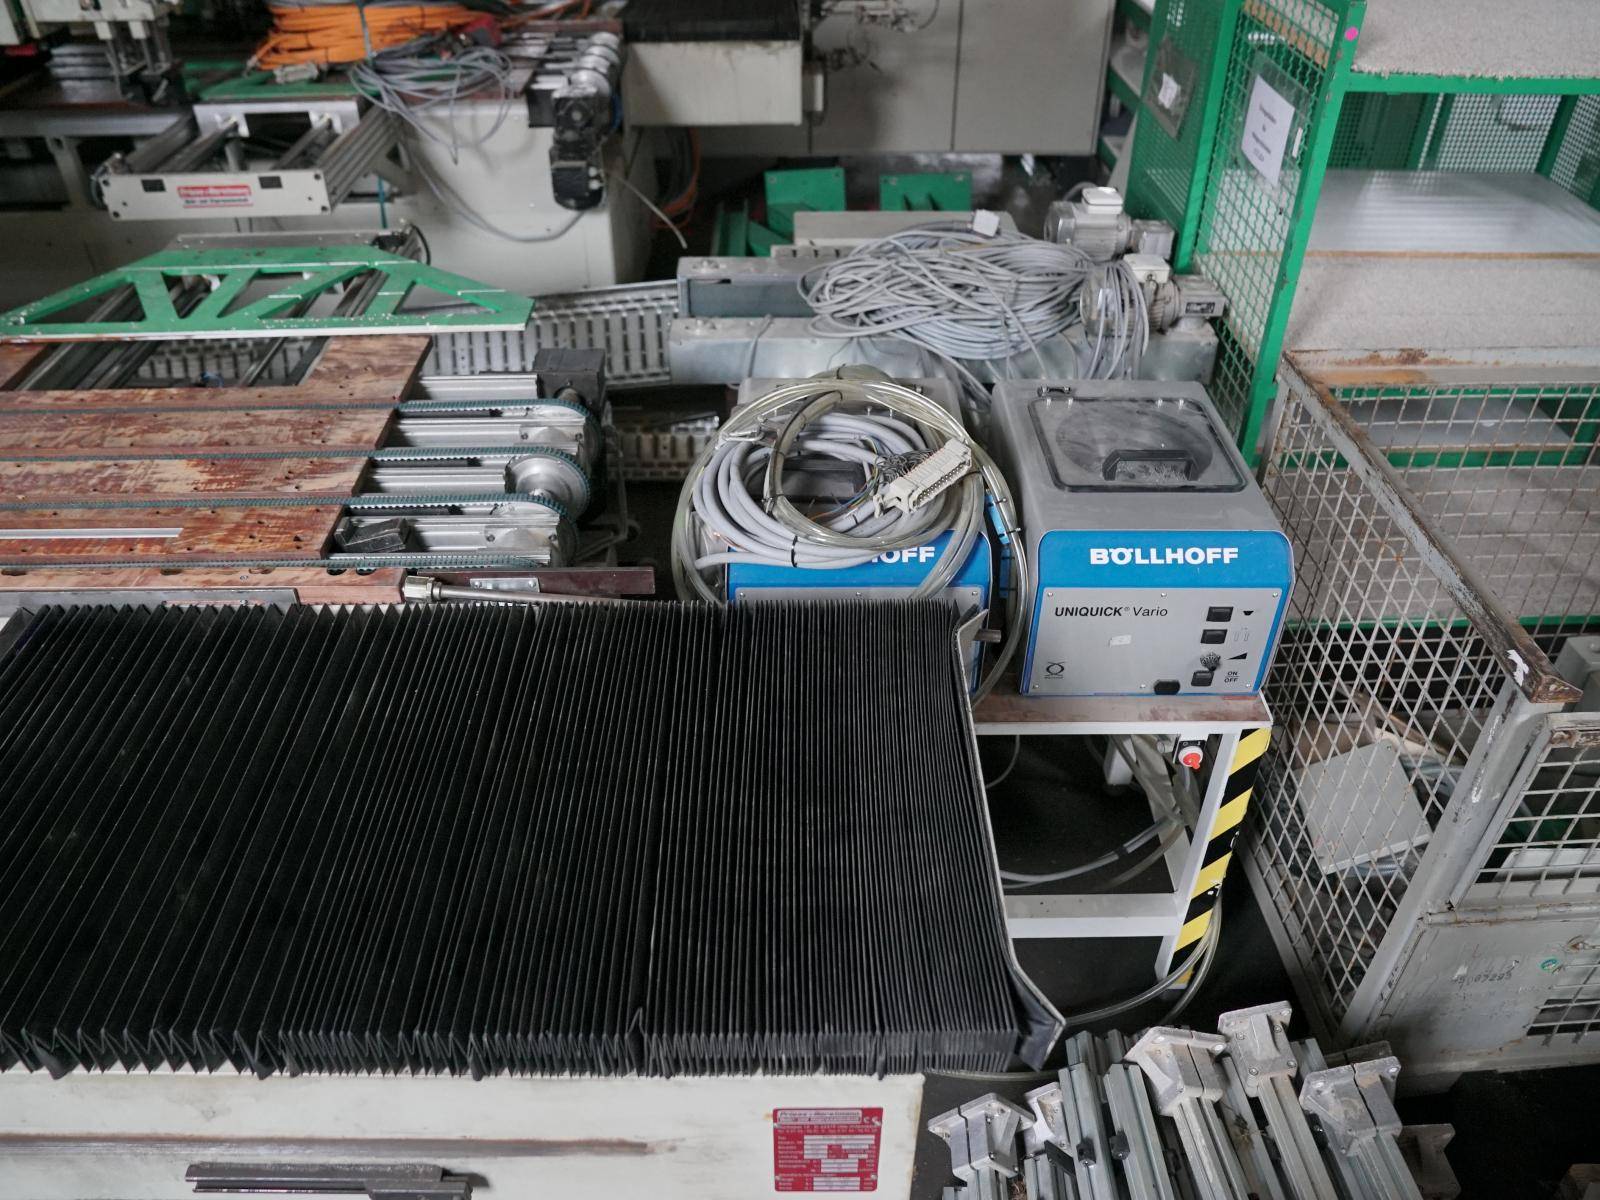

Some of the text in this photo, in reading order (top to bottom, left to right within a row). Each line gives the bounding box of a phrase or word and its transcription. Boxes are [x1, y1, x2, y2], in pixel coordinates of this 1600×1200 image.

[871, 546, 936, 564] OFF
[1089, 546, 1239, 566] BÖLLHOFF
[1132, 606, 1168, 617] Vario
